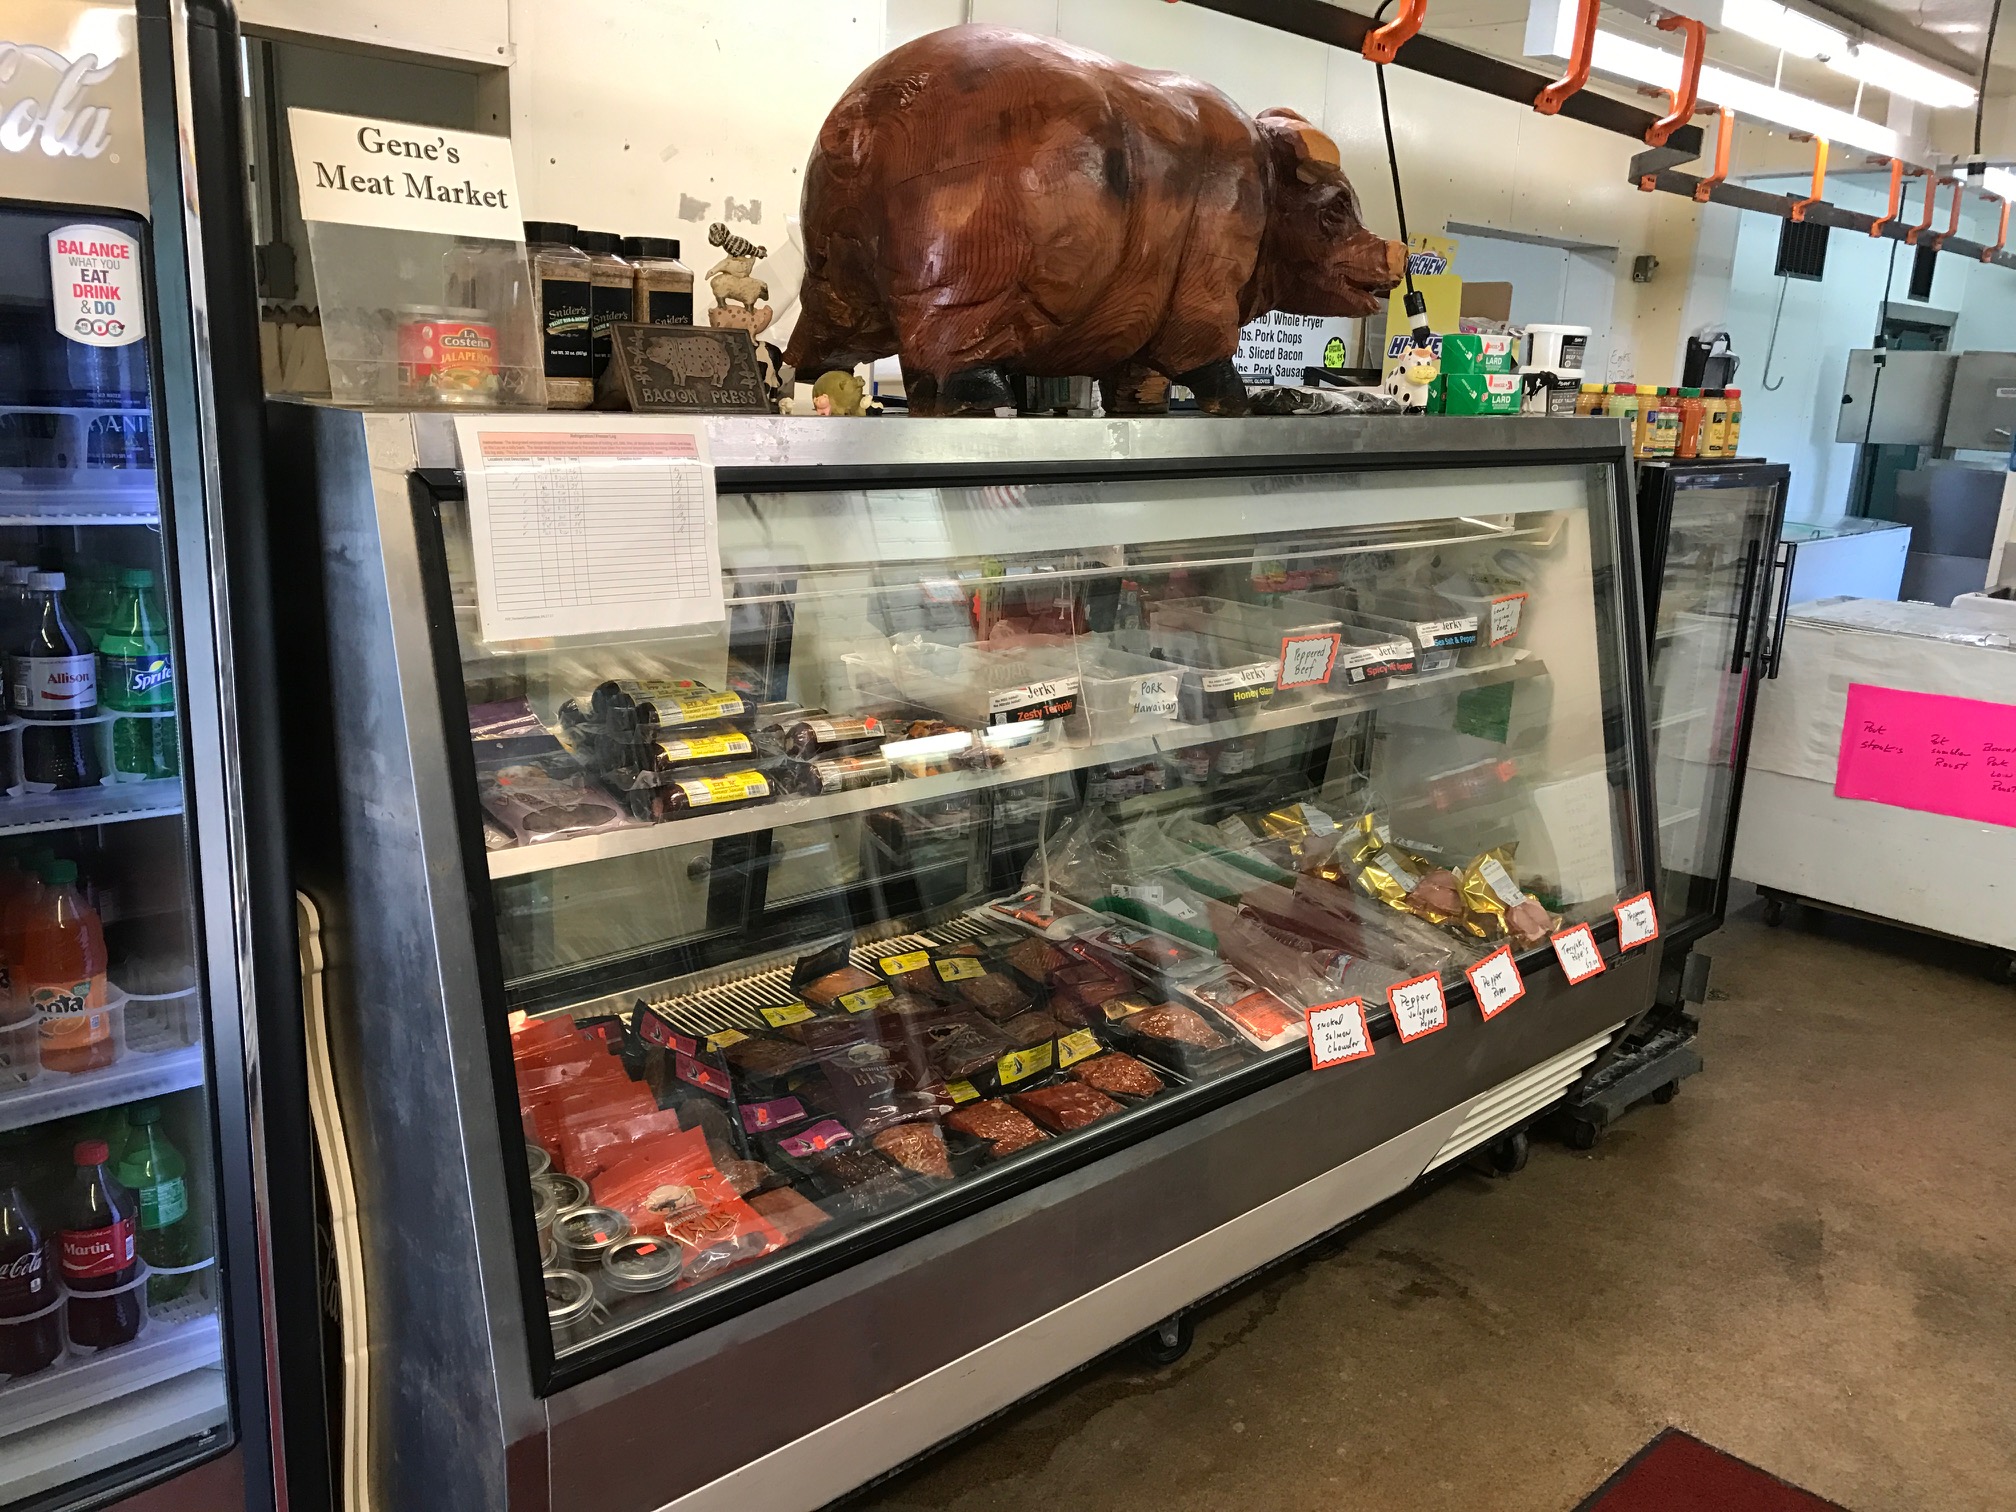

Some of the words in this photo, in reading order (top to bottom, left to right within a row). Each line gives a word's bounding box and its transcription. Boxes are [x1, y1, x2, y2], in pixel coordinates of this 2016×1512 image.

[357, 126, 460, 164] Gene's
[313, 161, 395, 196] Meat
[402, 172, 508, 209] Market
[57, 240, 130, 260] BALANCE
[68, 256, 98, 268] WHAT
[99, 258, 121, 270] YOU
[72, 283, 122, 301] DRINK
[80, 300, 92, 314] &
[94, 300, 116, 316] DO
[548, 305, 587, 320] Snider's
[593, 310, 629, 324] Snider's
[1274, 312, 1300, 326] Whole
[1302, 315, 1324, 330] Fryer
[464, 330, 475, 339] La
[1241, 328, 1253, 341] bs.
[1255, 329, 1274, 342] Pork
[1277, 330, 1302, 346] Chops
[1249, 346, 1275, 360] Sliced
[1277, 347, 1303, 361] Bacon
[1485, 357, 1503, 365] LARD
[1275, 364, 1305, 380] Sausag
[642, 388, 699, 404] BACON
[710, 390, 757, 405] PRESS
[1491, 395, 1511, 404] LARD
[1460, 634, 1476, 644] Pepper
[1294, 644, 1327, 665] Peppered
[1240, 667, 1266, 682] Jerky
[1294, 658, 1317, 678] Beef
[1366, 665, 1388, 677] Spicy
[47, 671, 90, 684] Allison
[132, 665, 172, 690] Sprite
[1027, 682, 1056, 699] Jerky
[1233, 689, 1259, 701] Honey
[1017, 708, 1043, 722] Zesty
[1043, 699, 1073, 715] Teriyaki
[63, 1241, 112, 1256] Martin
